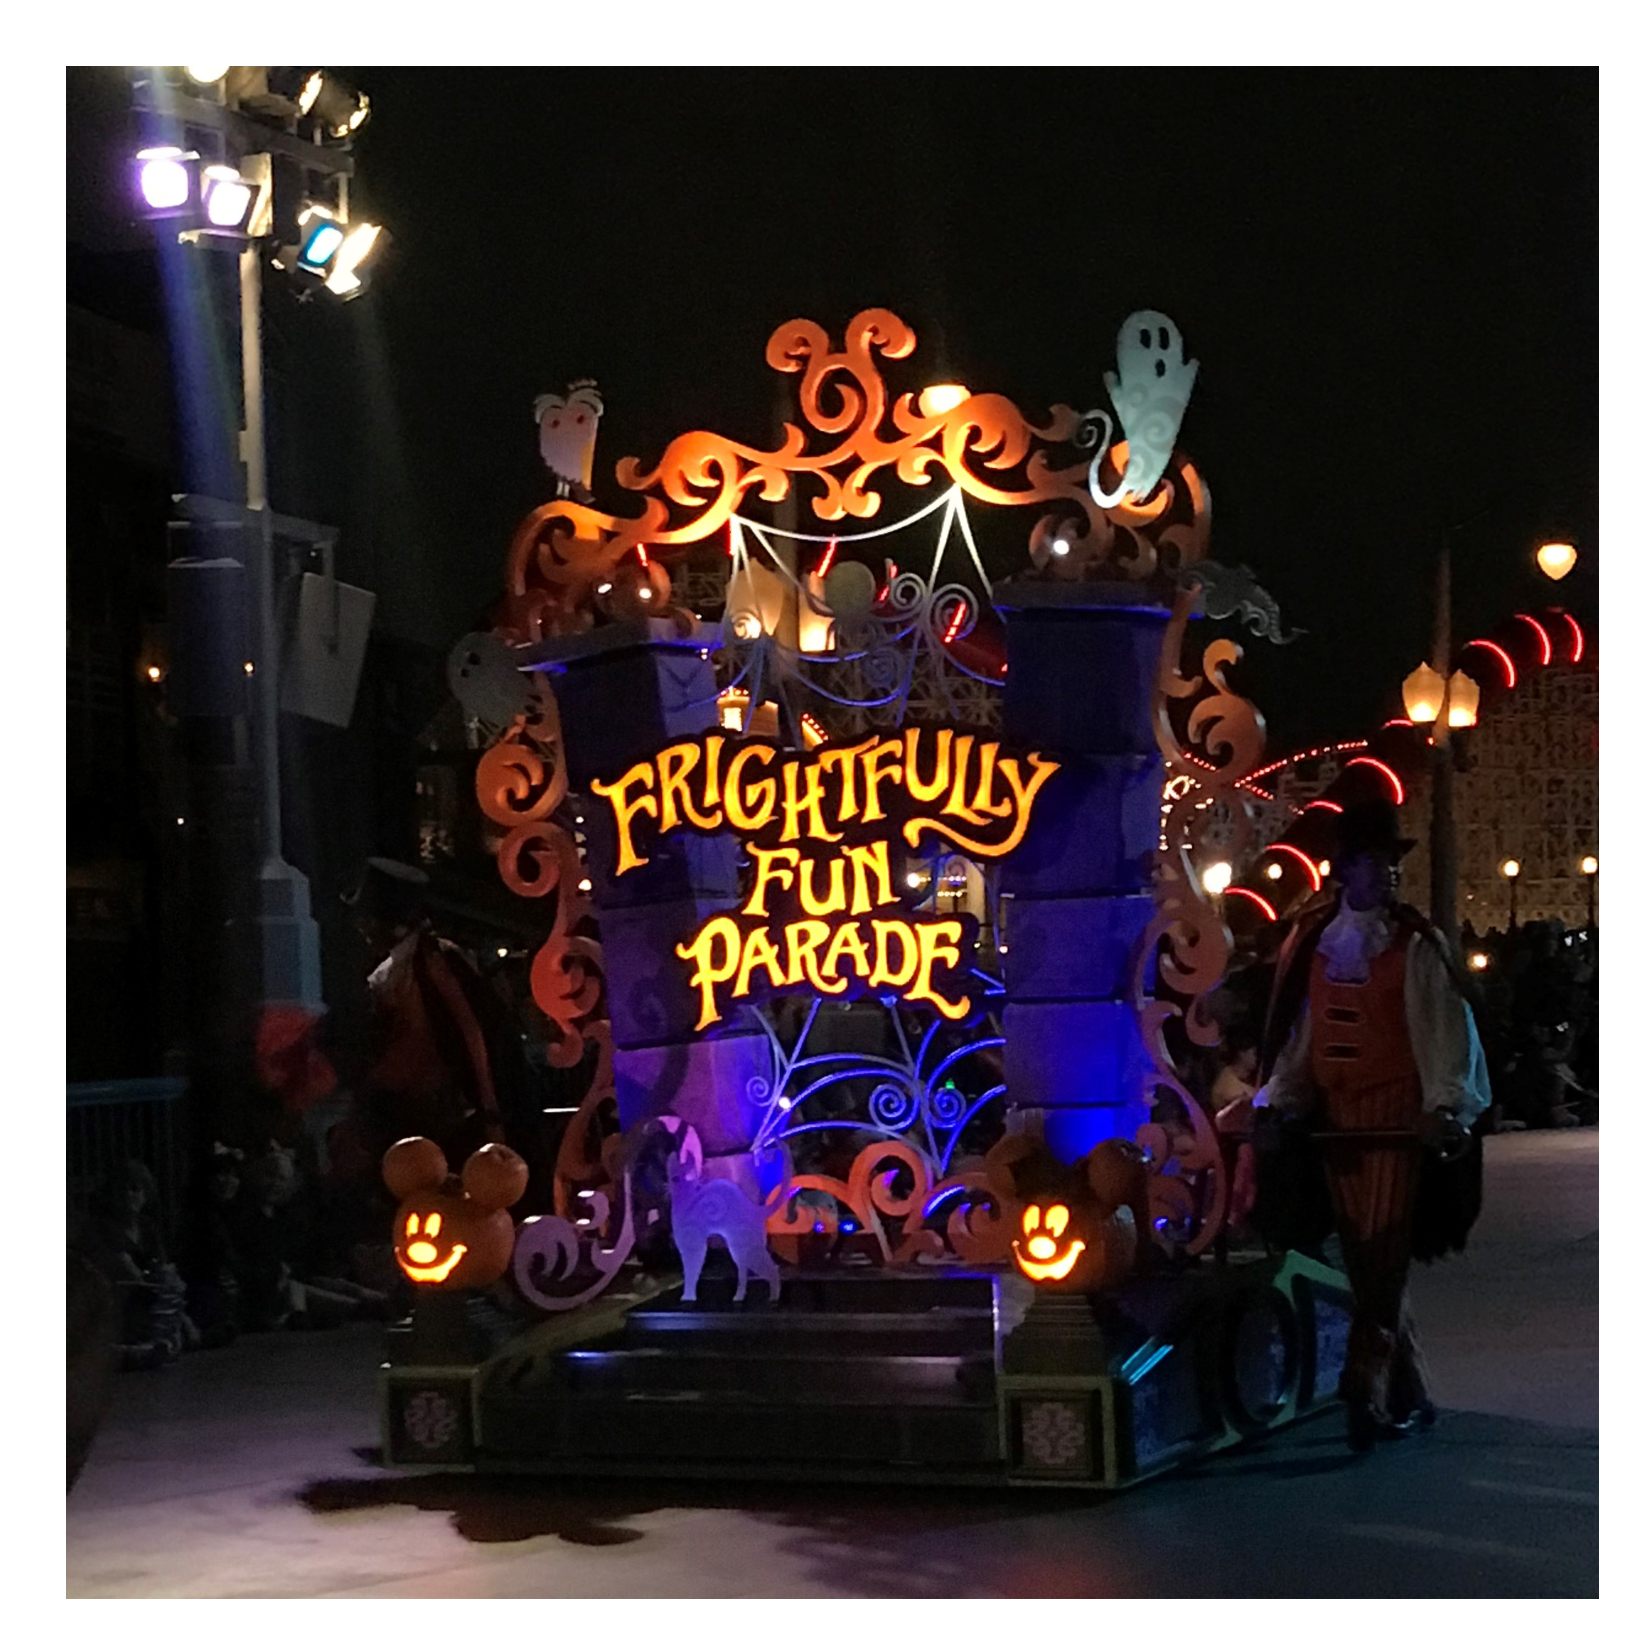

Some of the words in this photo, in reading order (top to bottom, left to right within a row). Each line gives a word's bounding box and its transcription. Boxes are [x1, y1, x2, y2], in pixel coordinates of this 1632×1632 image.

[590, 726, 1063, 878] FRIGHTFULLY
[740, 840, 902, 918] FUN
[674, 915, 972, 1032] PARADE
